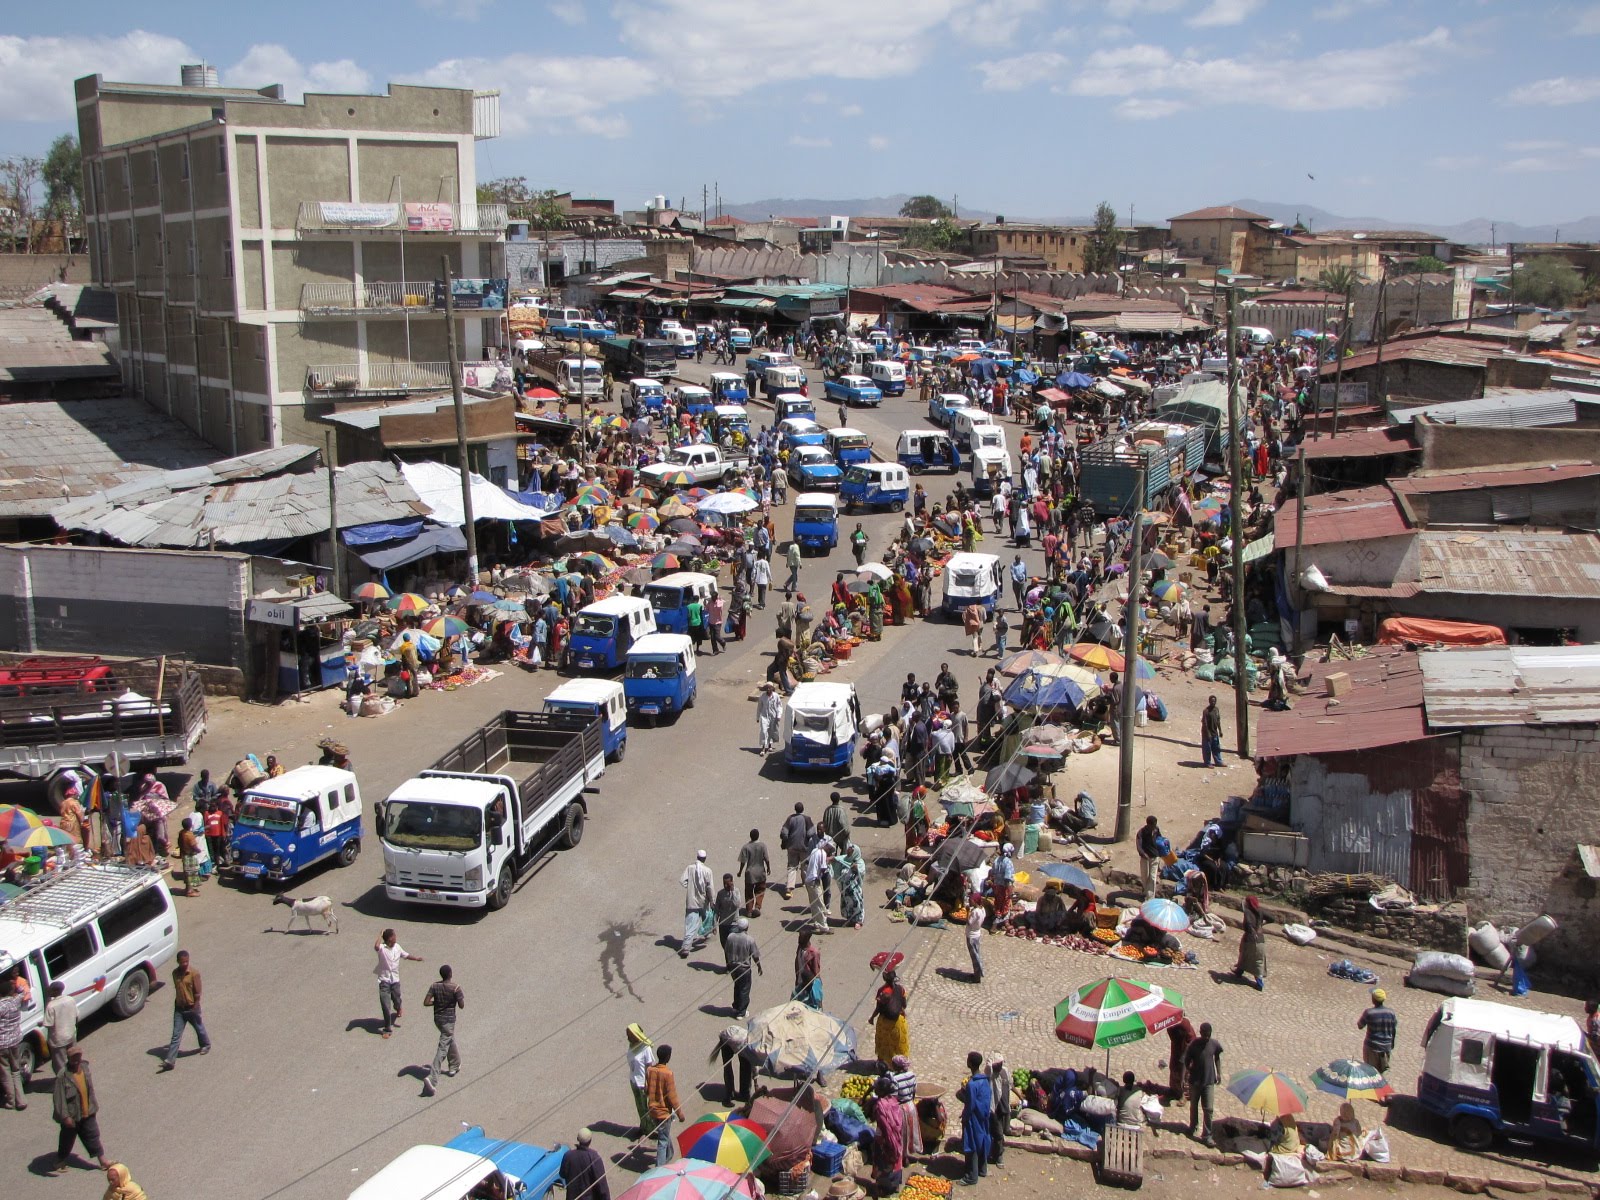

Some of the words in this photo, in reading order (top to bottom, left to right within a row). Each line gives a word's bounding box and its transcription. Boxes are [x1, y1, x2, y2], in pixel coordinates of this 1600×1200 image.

[1103, 1006, 1132, 1019] Empire
[1154, 1015, 1175, 1030] Empire
[1065, 1032, 1087, 1044] Empire
[1107, 1031, 1137, 1045] Empire
